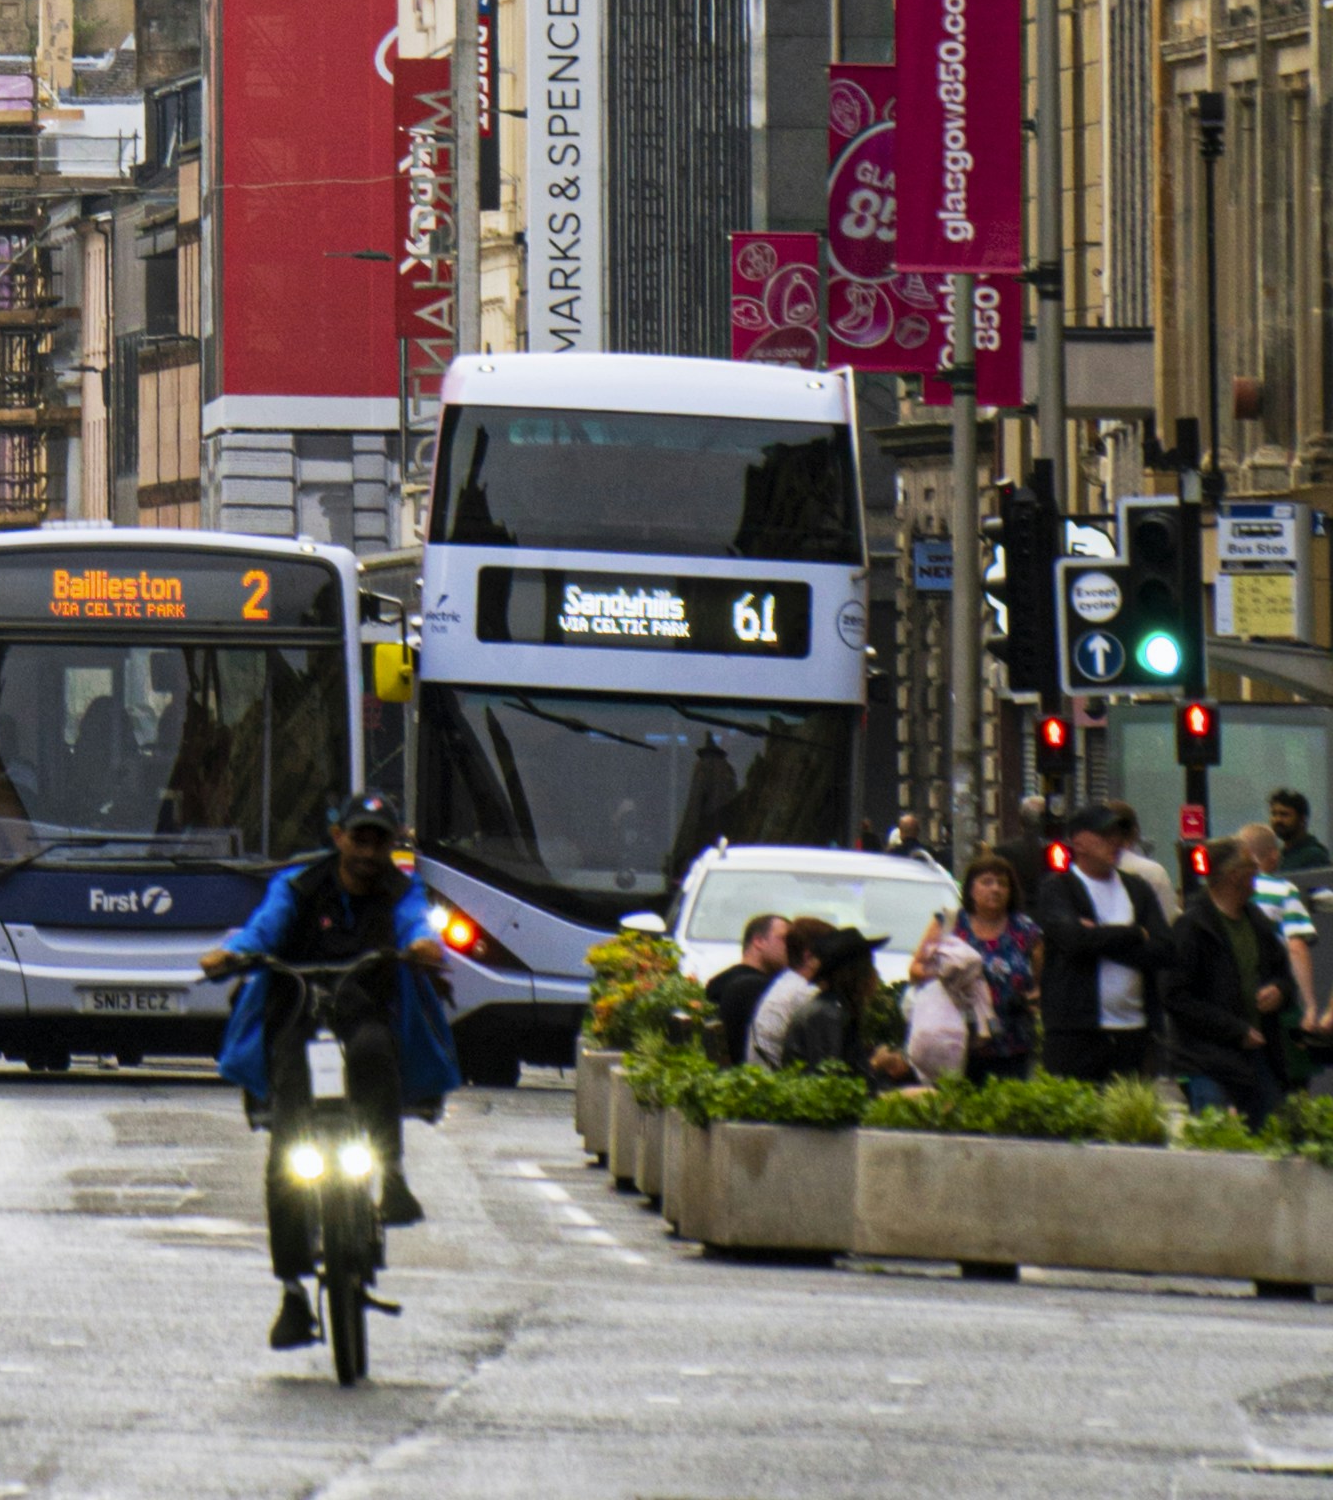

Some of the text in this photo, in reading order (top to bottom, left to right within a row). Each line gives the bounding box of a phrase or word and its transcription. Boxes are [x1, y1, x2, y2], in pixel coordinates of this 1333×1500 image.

[855, 160, 896, 190] GLA
[549, 175, 581, 203] &
[973, 286, 1001, 352] 850
[1228, 542, 1288, 557] Bus Stop
[53, 568, 271, 621] Baillieston 2
[1075, 583, 1118, 598] Except
[49, 602, 186, 618] VIA CELTIC PARK
[563, 584, 778, 642] Sandyhills 61
[1078, 600, 1119, 613] cycles
[558, 614, 691, 639] VIA CELTIC PARK
[89, 888, 139, 913] First
[93, 993, 171, 1011] SN13 ECZ
